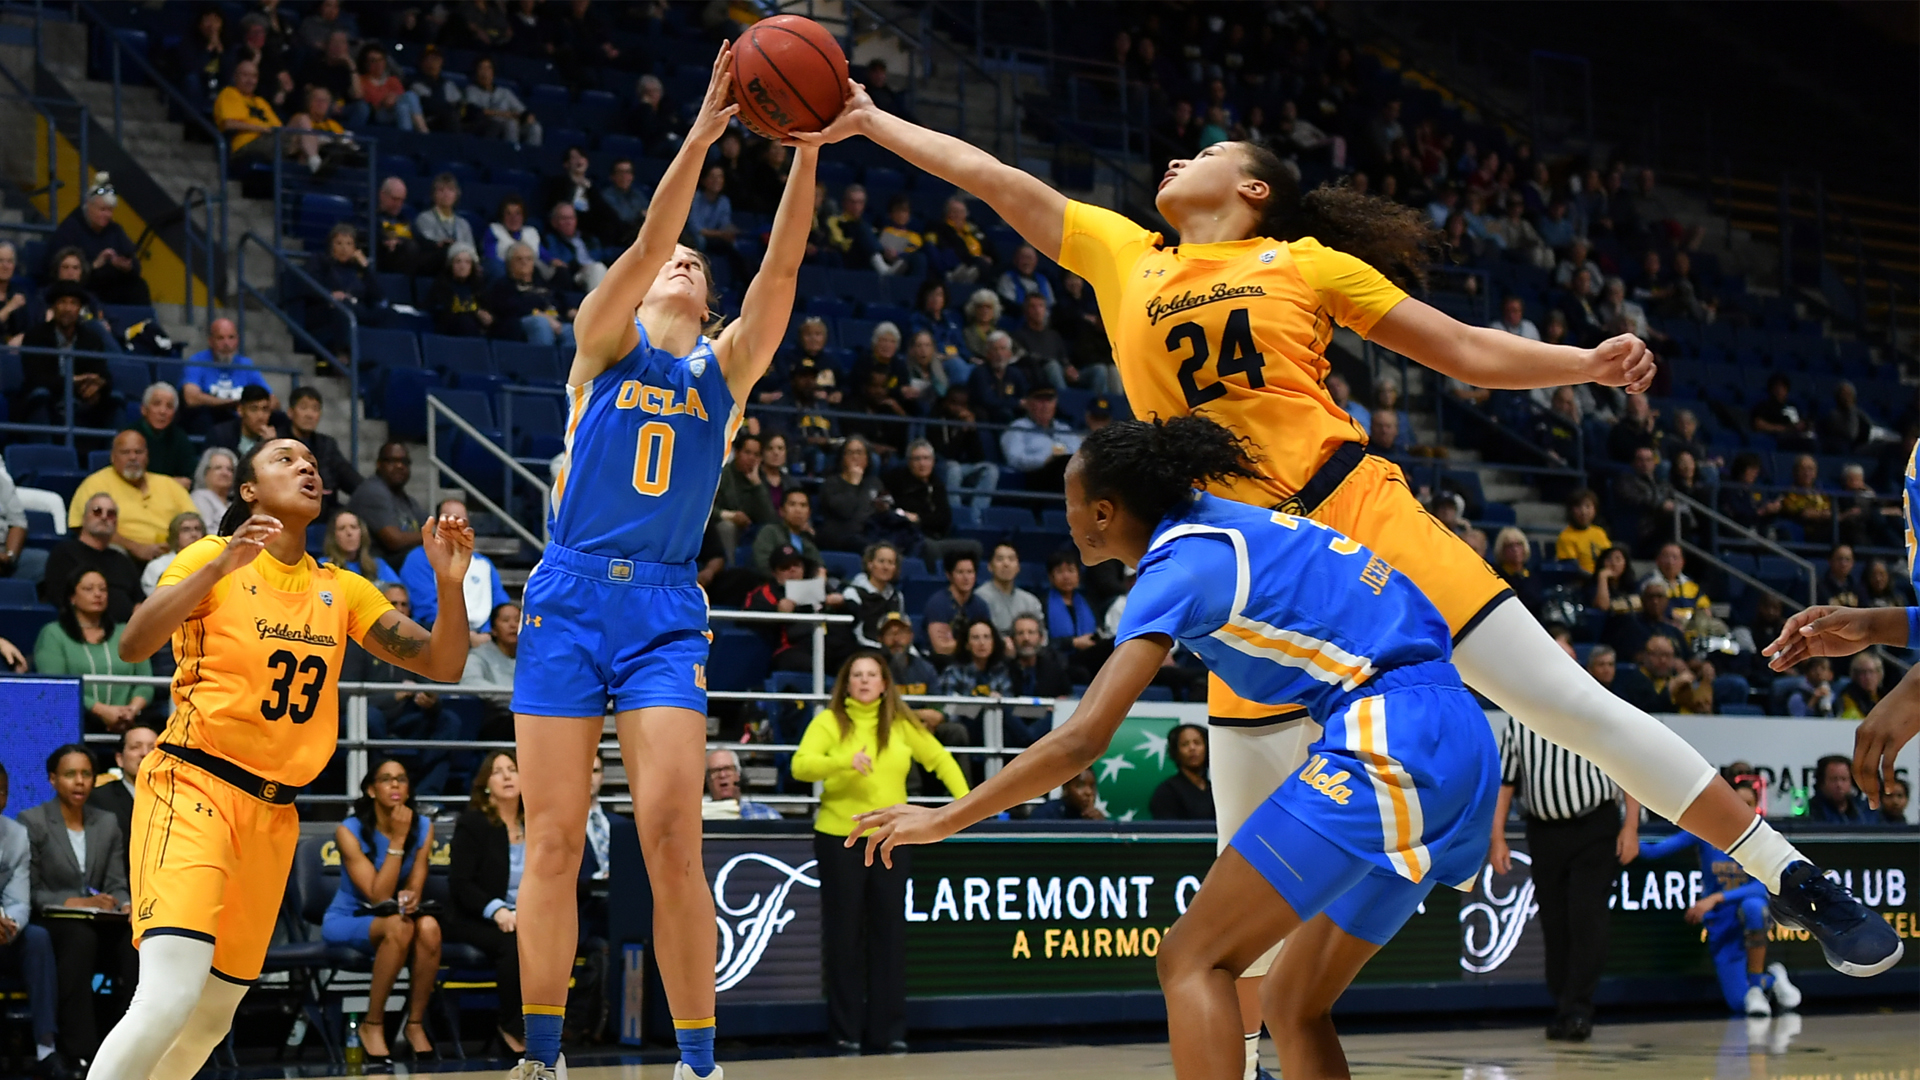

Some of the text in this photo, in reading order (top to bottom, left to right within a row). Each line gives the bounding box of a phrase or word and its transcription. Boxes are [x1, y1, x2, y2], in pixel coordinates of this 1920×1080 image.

[748, 77, 795, 127] NCAA
[1146, 282, 1266, 326] Golden Bears
[1164, 307, 1266, 409] 24
[632, 421, 676, 497] 0
[254, 617, 302, 640] Golden
[260, 649, 328, 724] 33
[1298, 754, 1353, 805] Ucla
[138, 897, 158, 922] Cal
[904, 876, 1155, 921] LAREMONT
[1012, 927, 1171, 960] A FAIRMO
